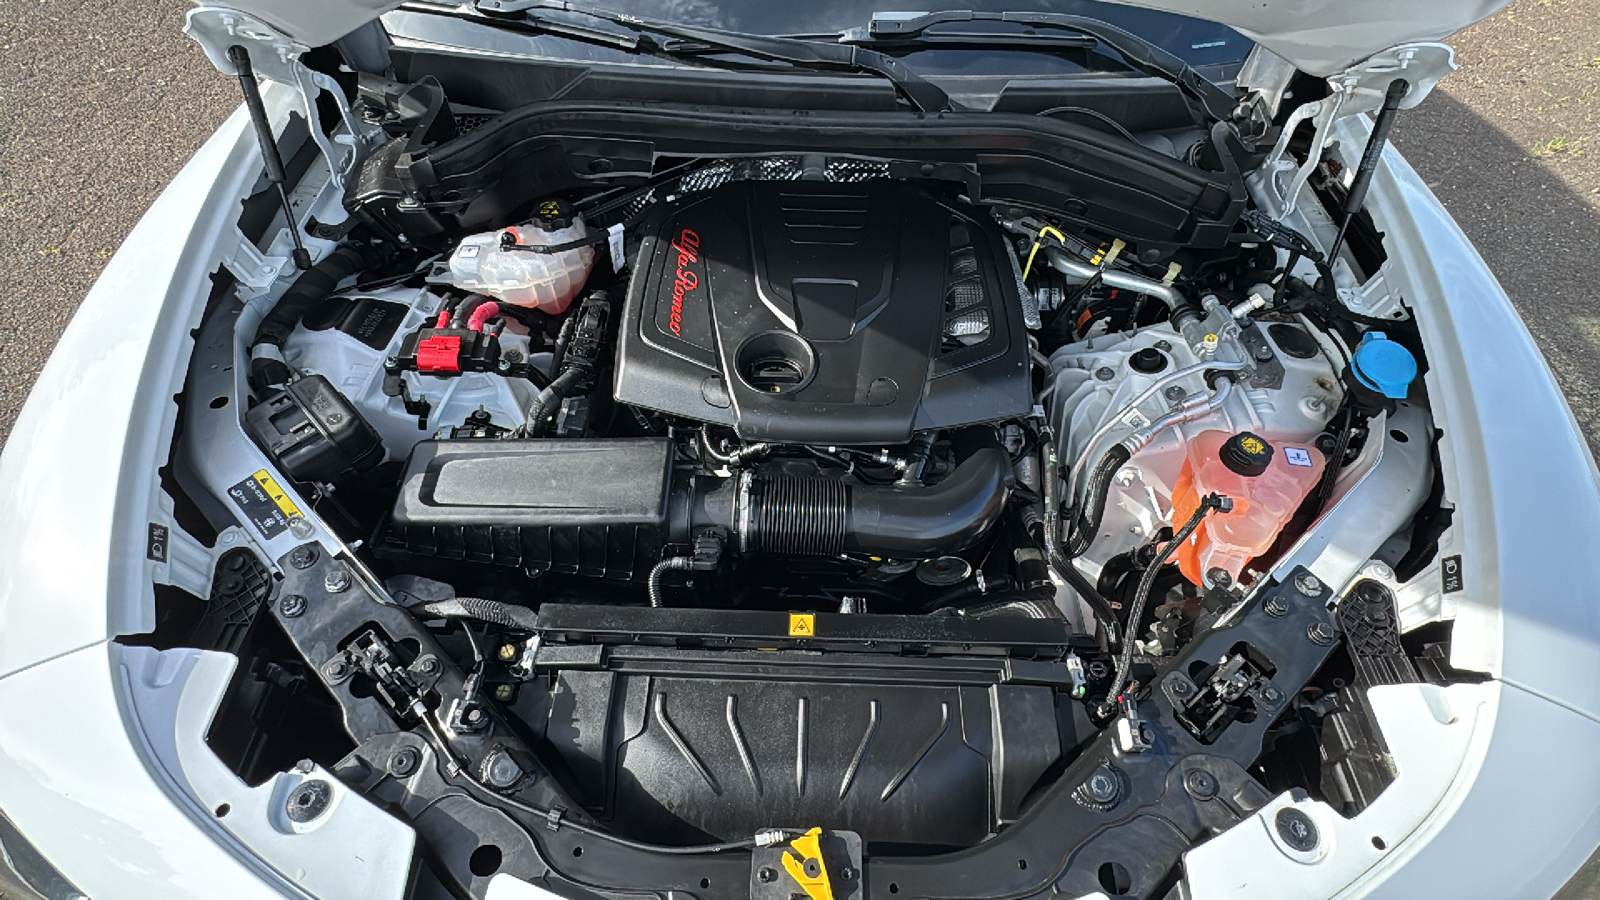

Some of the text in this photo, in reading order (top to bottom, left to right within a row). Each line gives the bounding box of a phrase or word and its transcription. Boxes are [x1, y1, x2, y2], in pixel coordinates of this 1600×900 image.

[669, 229, 700, 337] Alfa Romeo
[1446, 576, 1459, 590] 1%
